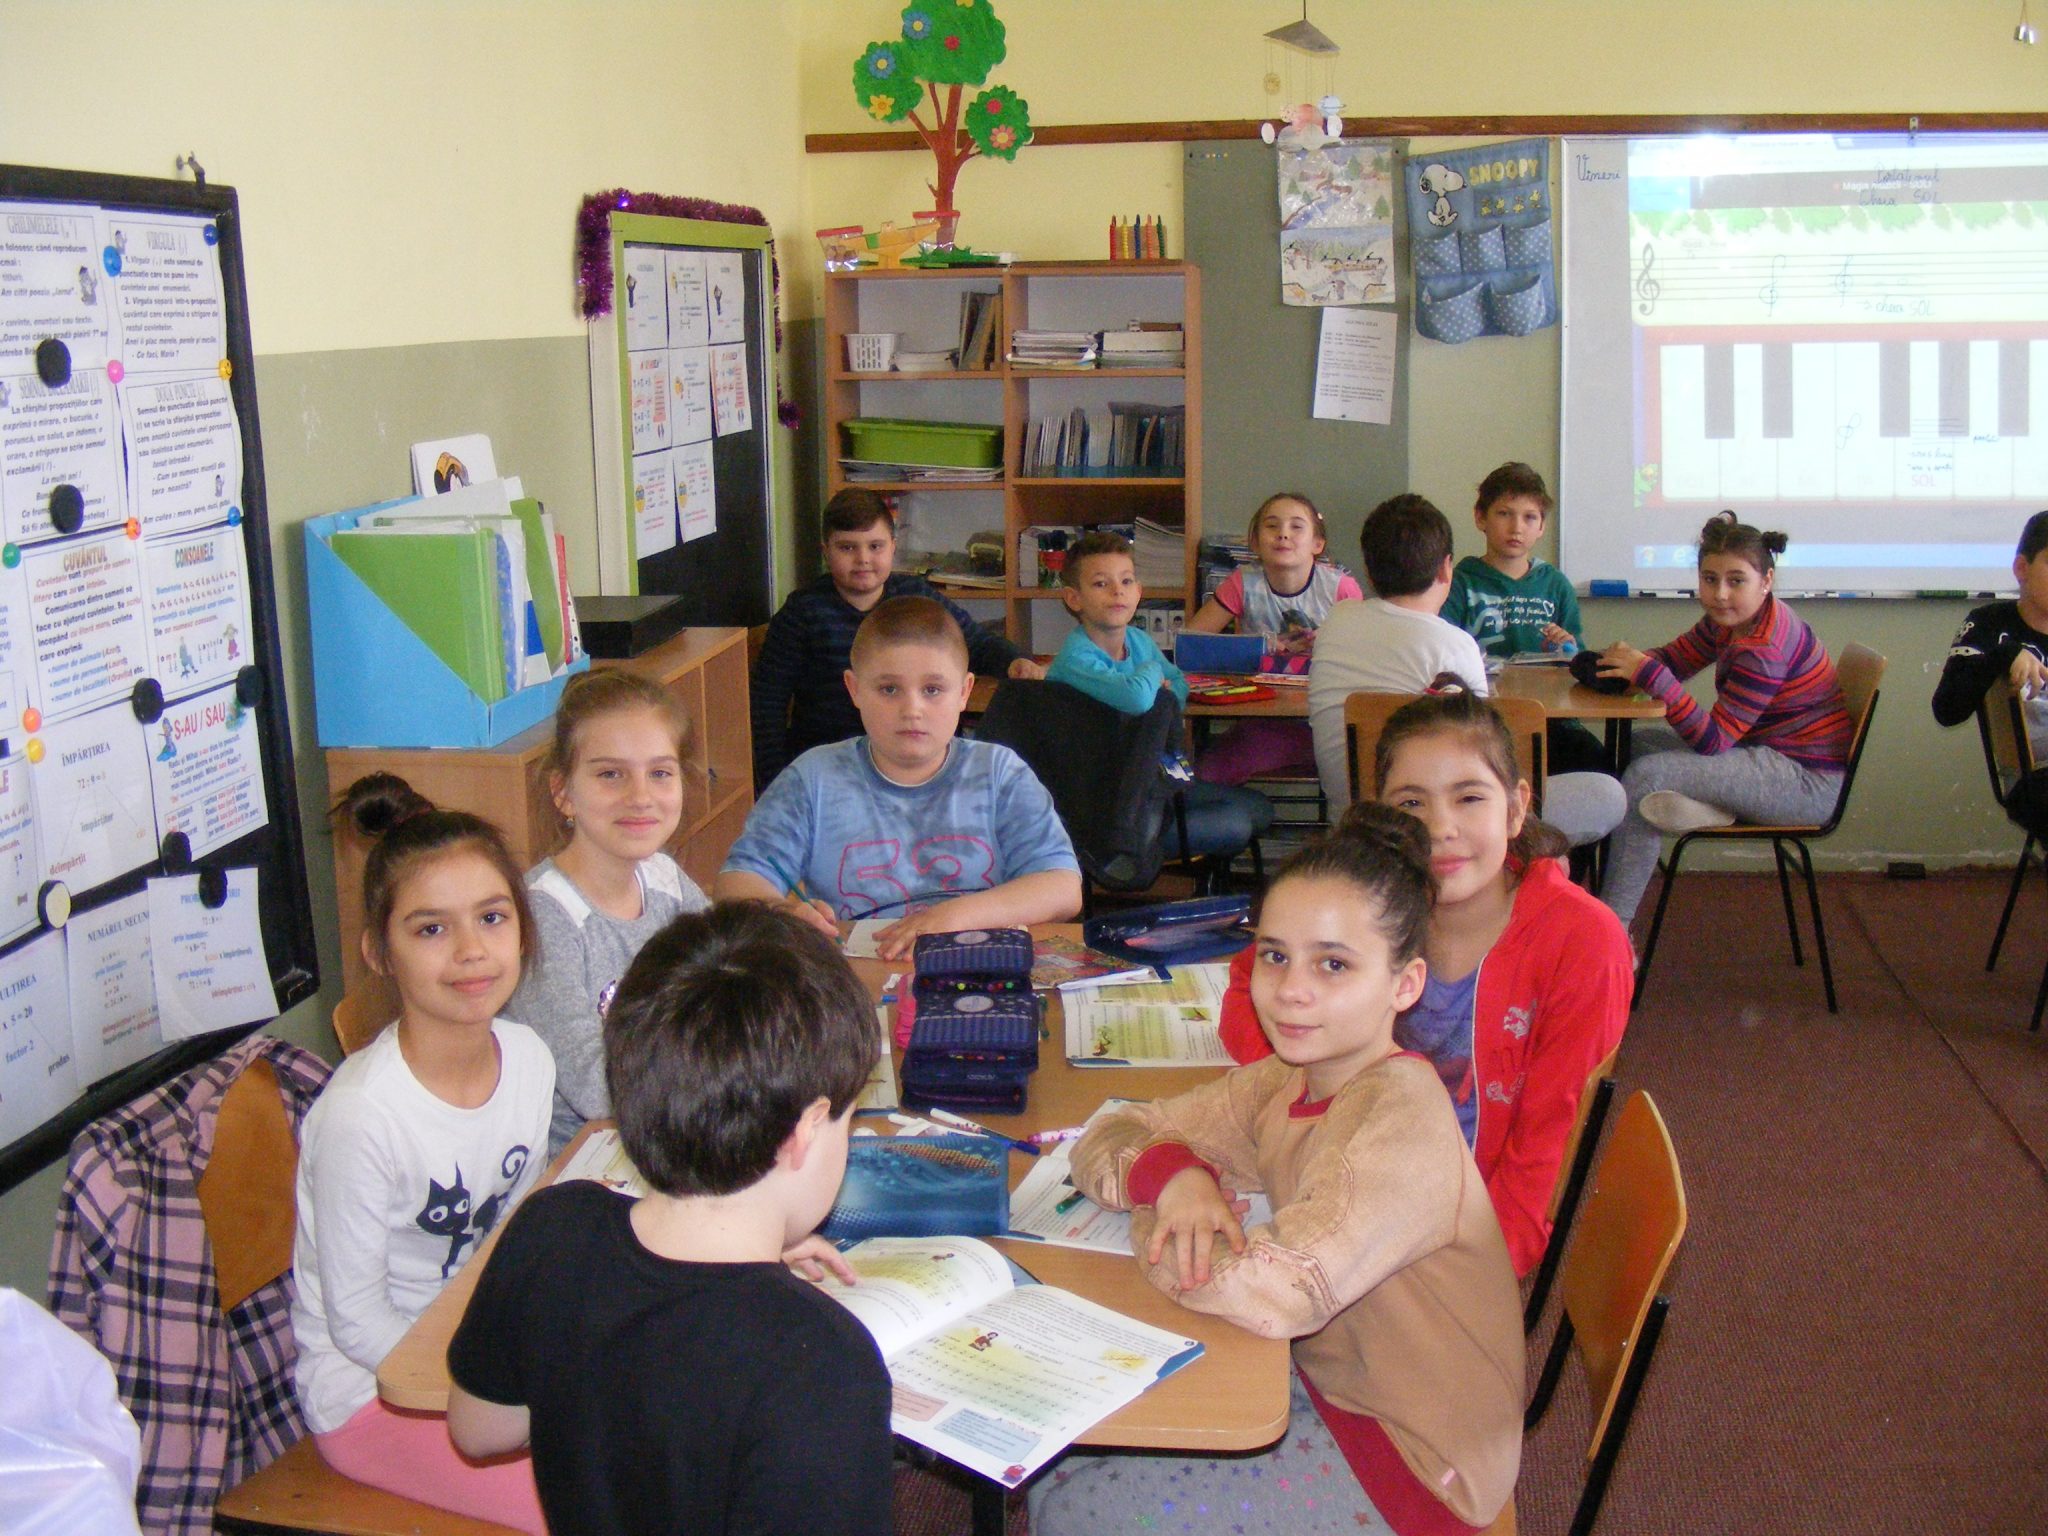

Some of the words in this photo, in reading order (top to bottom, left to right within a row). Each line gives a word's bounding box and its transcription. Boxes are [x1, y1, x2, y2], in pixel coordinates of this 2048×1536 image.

[1470, 158, 1538, 185] SNOOPY
[174, 712, 198, 740] S-AU
[205, 702, 226, 727] SAU
[48, 1054, 70, 1077] produs
